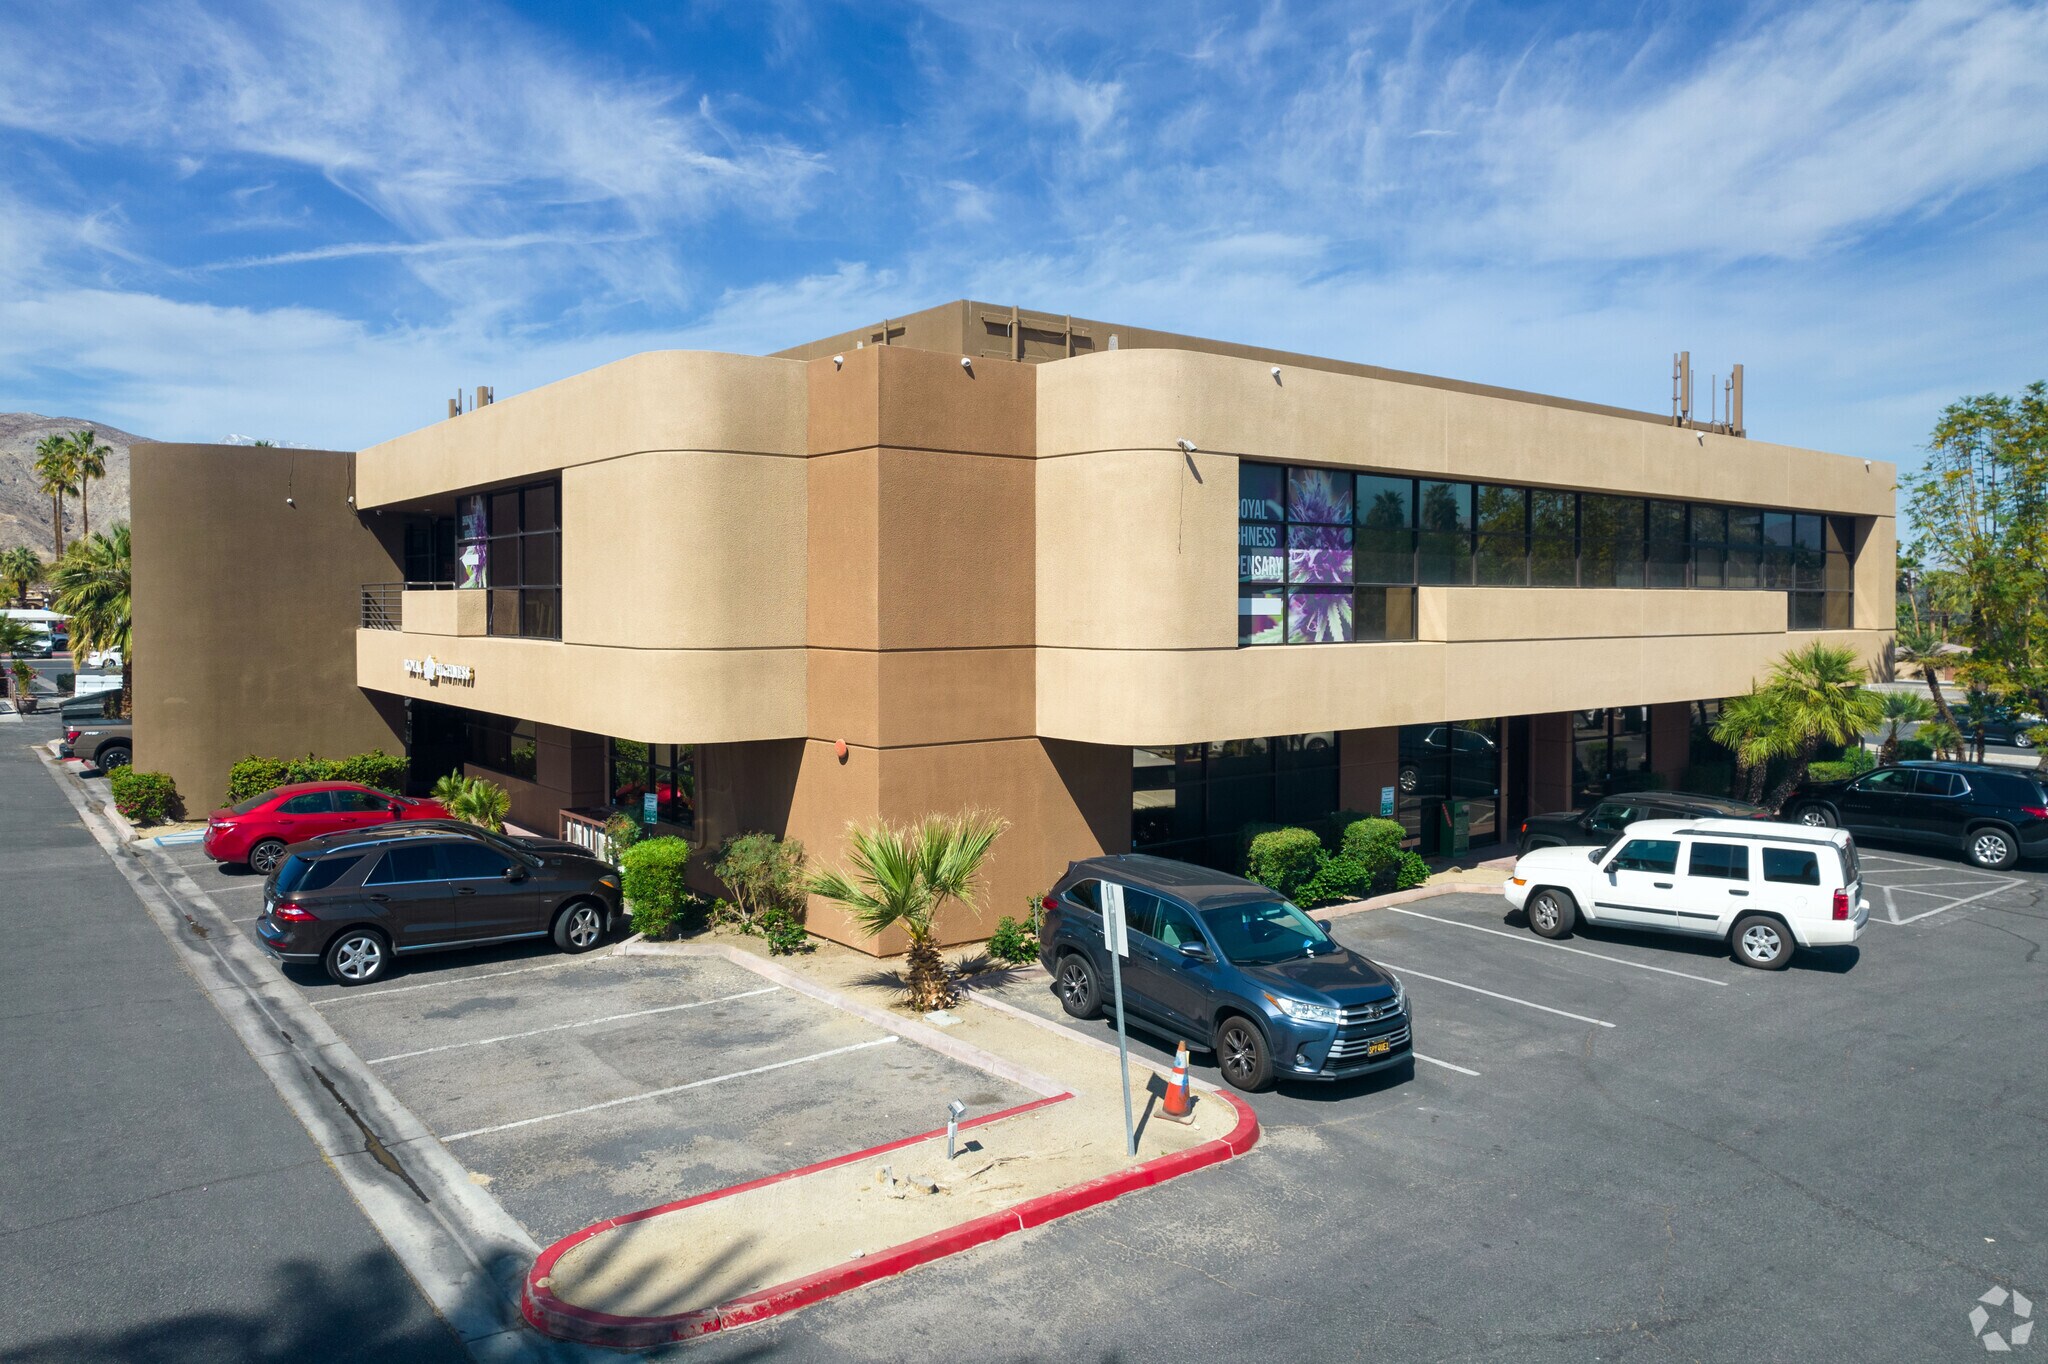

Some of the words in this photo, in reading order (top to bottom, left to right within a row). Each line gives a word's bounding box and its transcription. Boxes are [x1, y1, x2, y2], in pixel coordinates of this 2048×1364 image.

[1238, 498, 1268, 519] OYAL
[1238, 525, 1276, 547] HNESS
[1238, 554, 1284, 576] ENSARY
